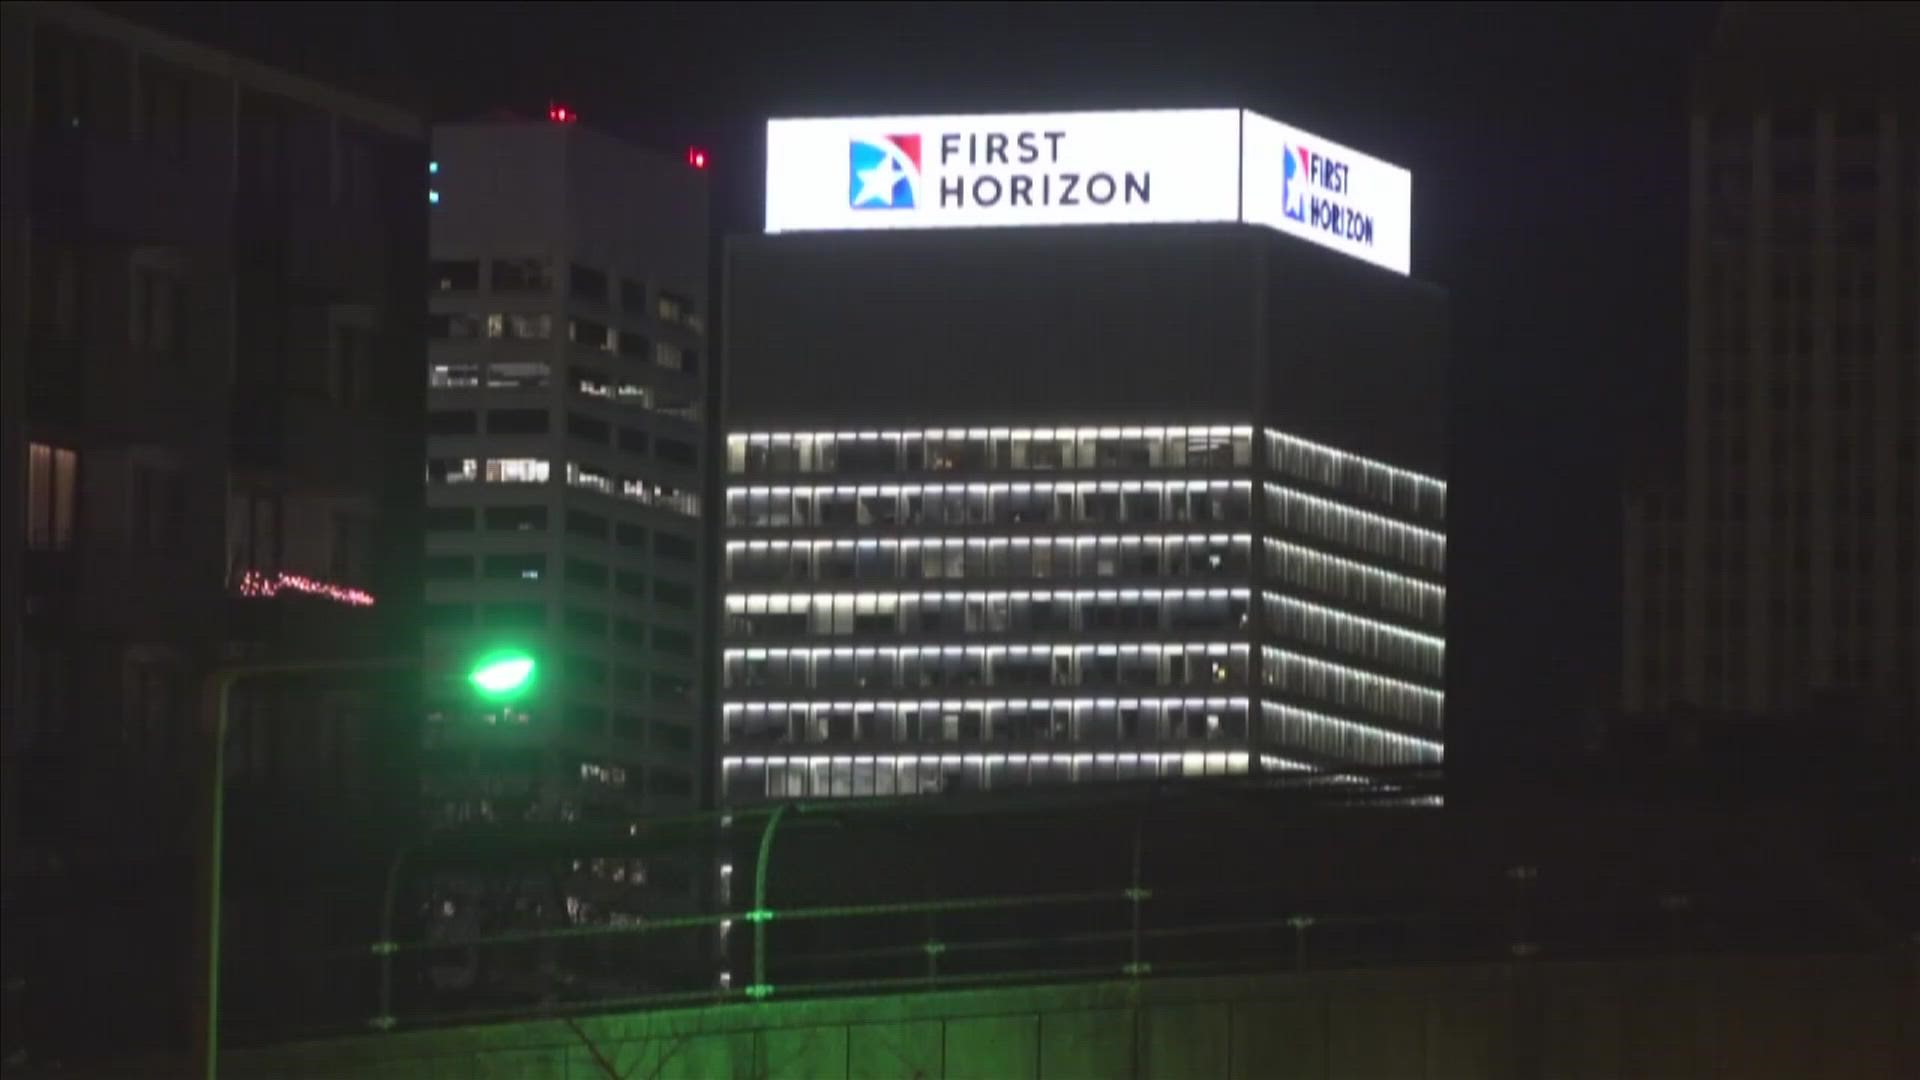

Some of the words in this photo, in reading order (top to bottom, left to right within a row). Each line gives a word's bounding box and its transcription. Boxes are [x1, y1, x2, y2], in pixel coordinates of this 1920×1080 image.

[940, 132, 1066, 165] FIRST
[940, 172, 1151, 208] HORIZON
[1311, 152, 1349, 195] FIRST
[1311, 194, 1374, 247] HORIZON
